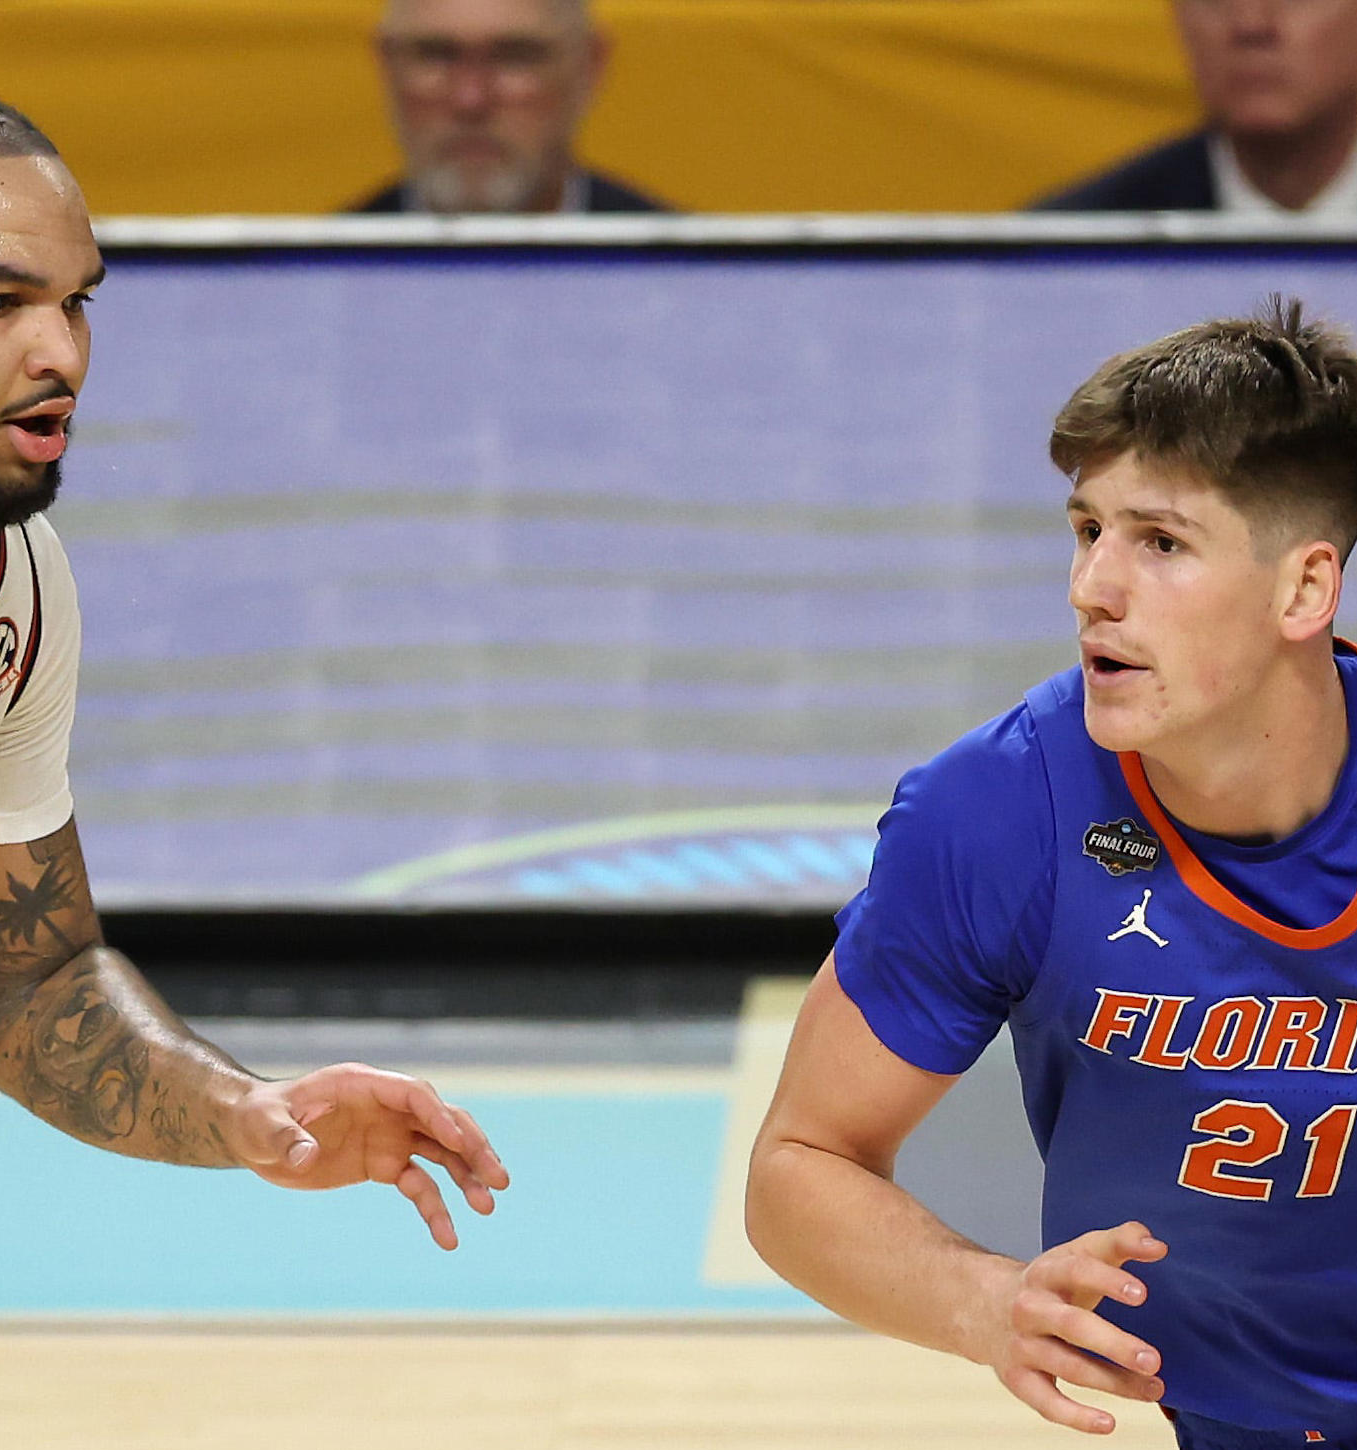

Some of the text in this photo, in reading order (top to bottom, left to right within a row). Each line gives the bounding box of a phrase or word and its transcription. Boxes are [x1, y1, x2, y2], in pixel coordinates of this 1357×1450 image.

[1088, 832, 1157, 860] FINAL FOUR
[1177, 1099, 1357, 1202] 21
